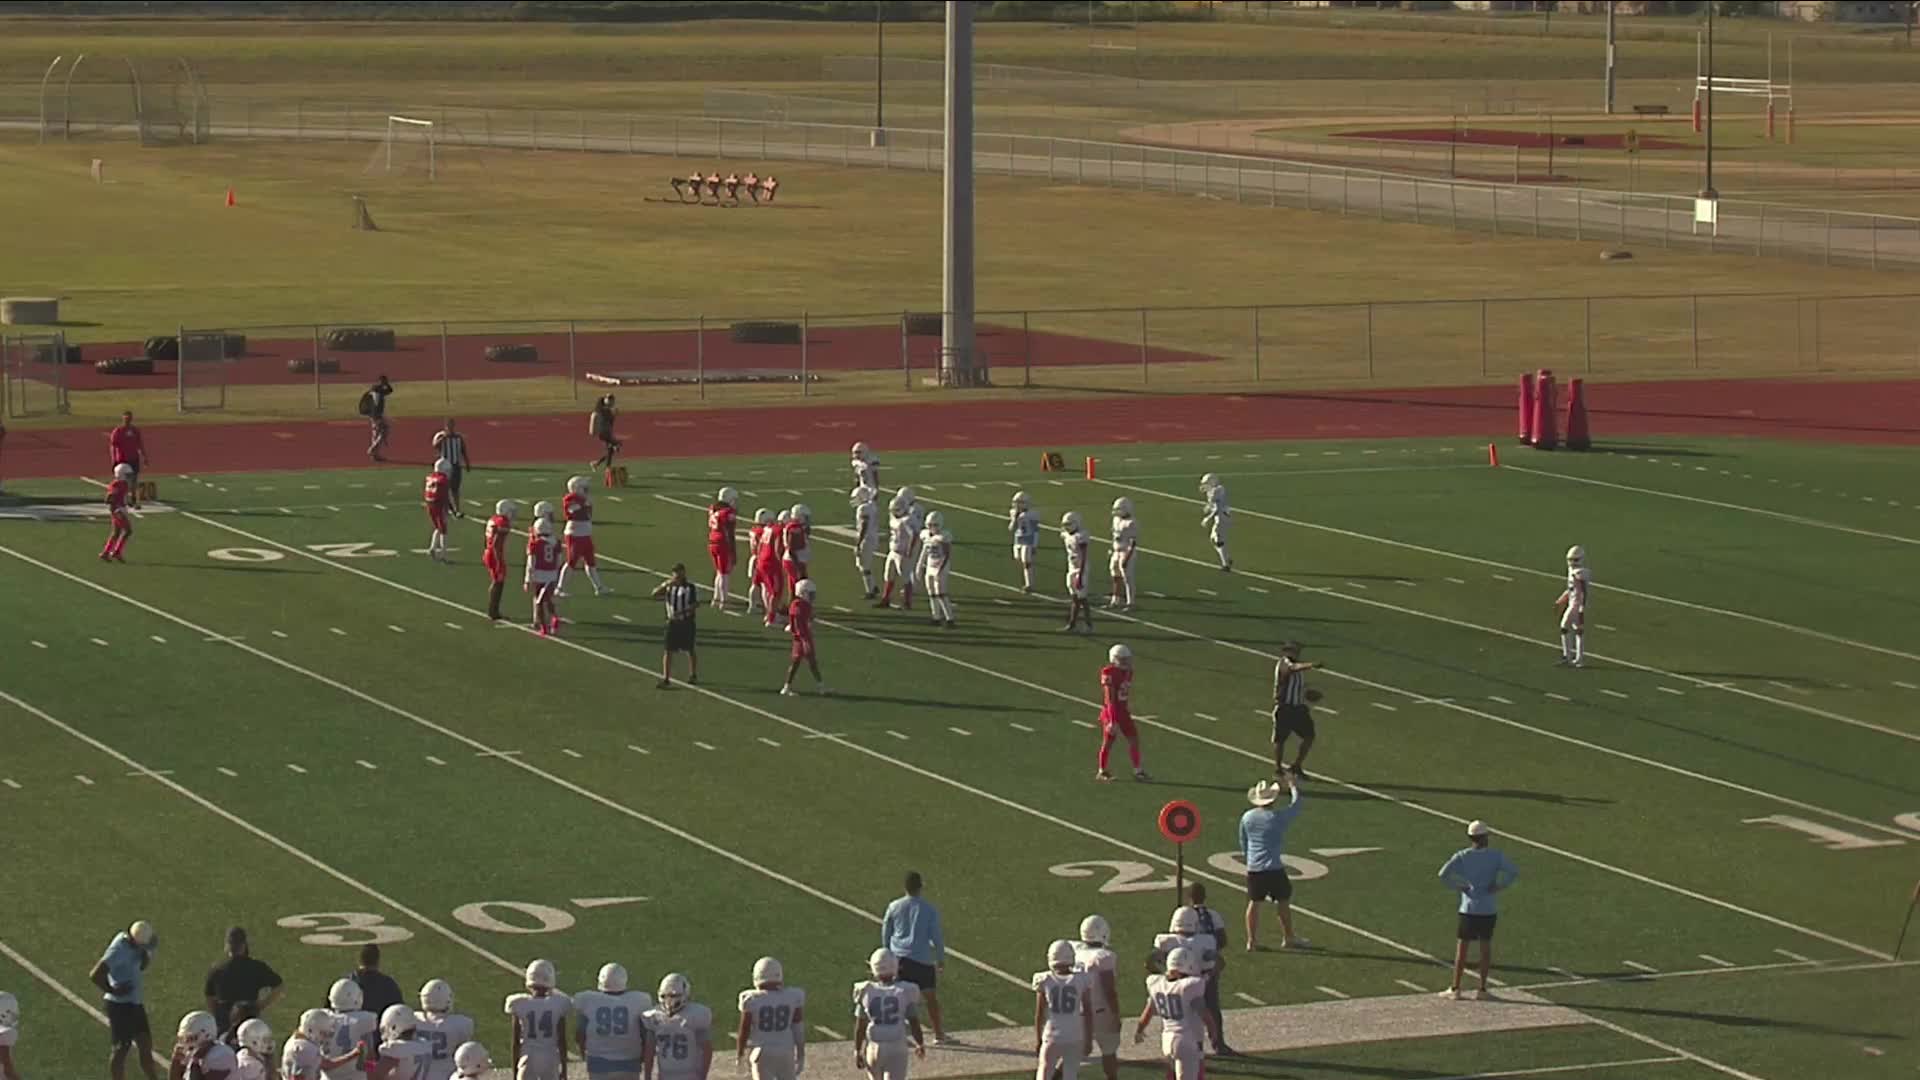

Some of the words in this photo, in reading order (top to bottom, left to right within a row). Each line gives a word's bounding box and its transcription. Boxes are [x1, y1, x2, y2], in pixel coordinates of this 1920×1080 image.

[1050, 985, 1078, 1014] 16
[1155, 992, 1184, 1020] 80
[526, 1010, 553, 1039] 14
[596, 1006, 629, 1035] 99
[657, 1034, 689, 1060] 76
